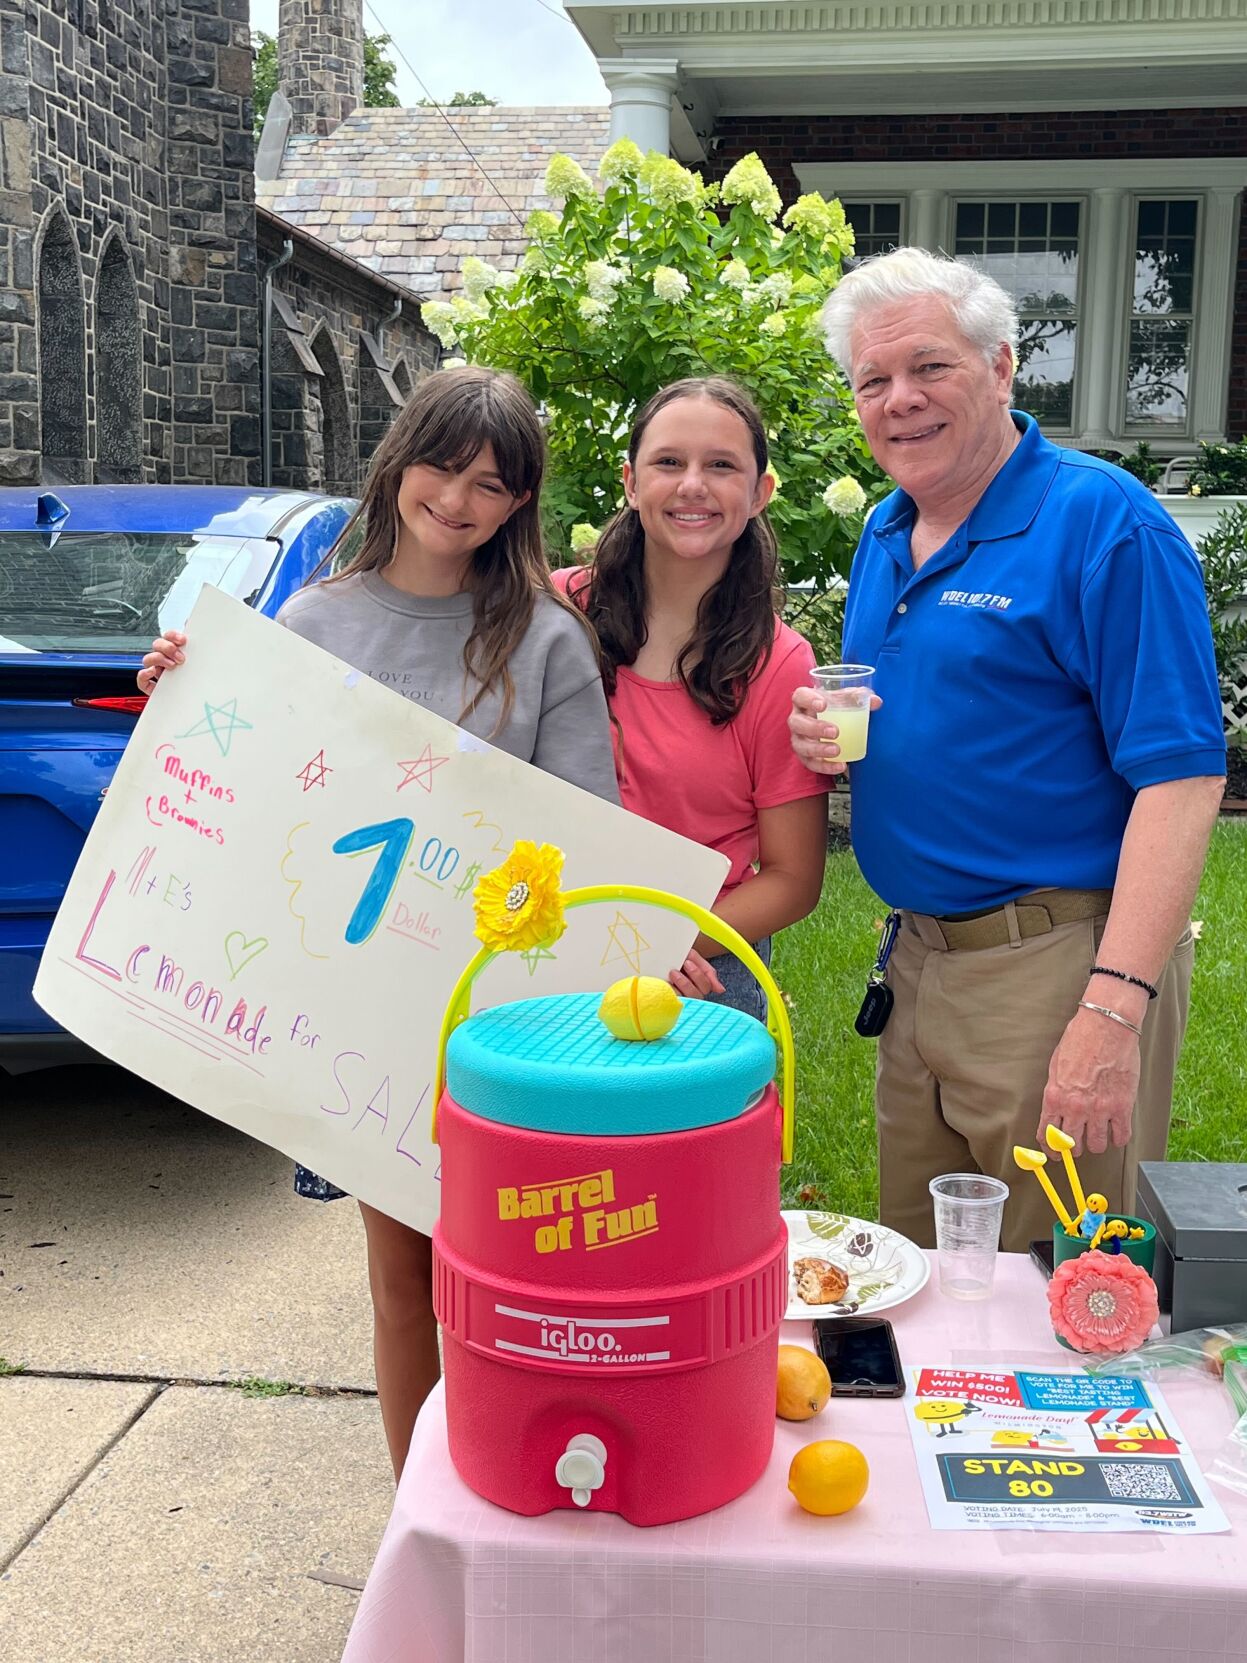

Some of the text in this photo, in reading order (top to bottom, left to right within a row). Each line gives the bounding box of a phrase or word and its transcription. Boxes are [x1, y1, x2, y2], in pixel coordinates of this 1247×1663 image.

[163, 755, 236, 804] Muffins
[158, 794, 226, 846] Brownies
[391, 902, 442, 940] Dollar
[75, 868, 321, 1055] Lemonade for
[497, 1168, 616, 1221] Barrel
[535, 1216, 574, 1254] of
[590, 1353, 647, 1363] 2-GALLON
[932, 1370, 1006, 1383] HELP ME
[930, 1379, 1010, 1394] WIN $500!
[921, 1389, 1021, 1407] VOTE NOW!
[1042, 1399, 1098, 1407] LEMONADE
[963, 1459, 1085, 1475] STAND
[1009, 1480, 1054, 1497] 80
